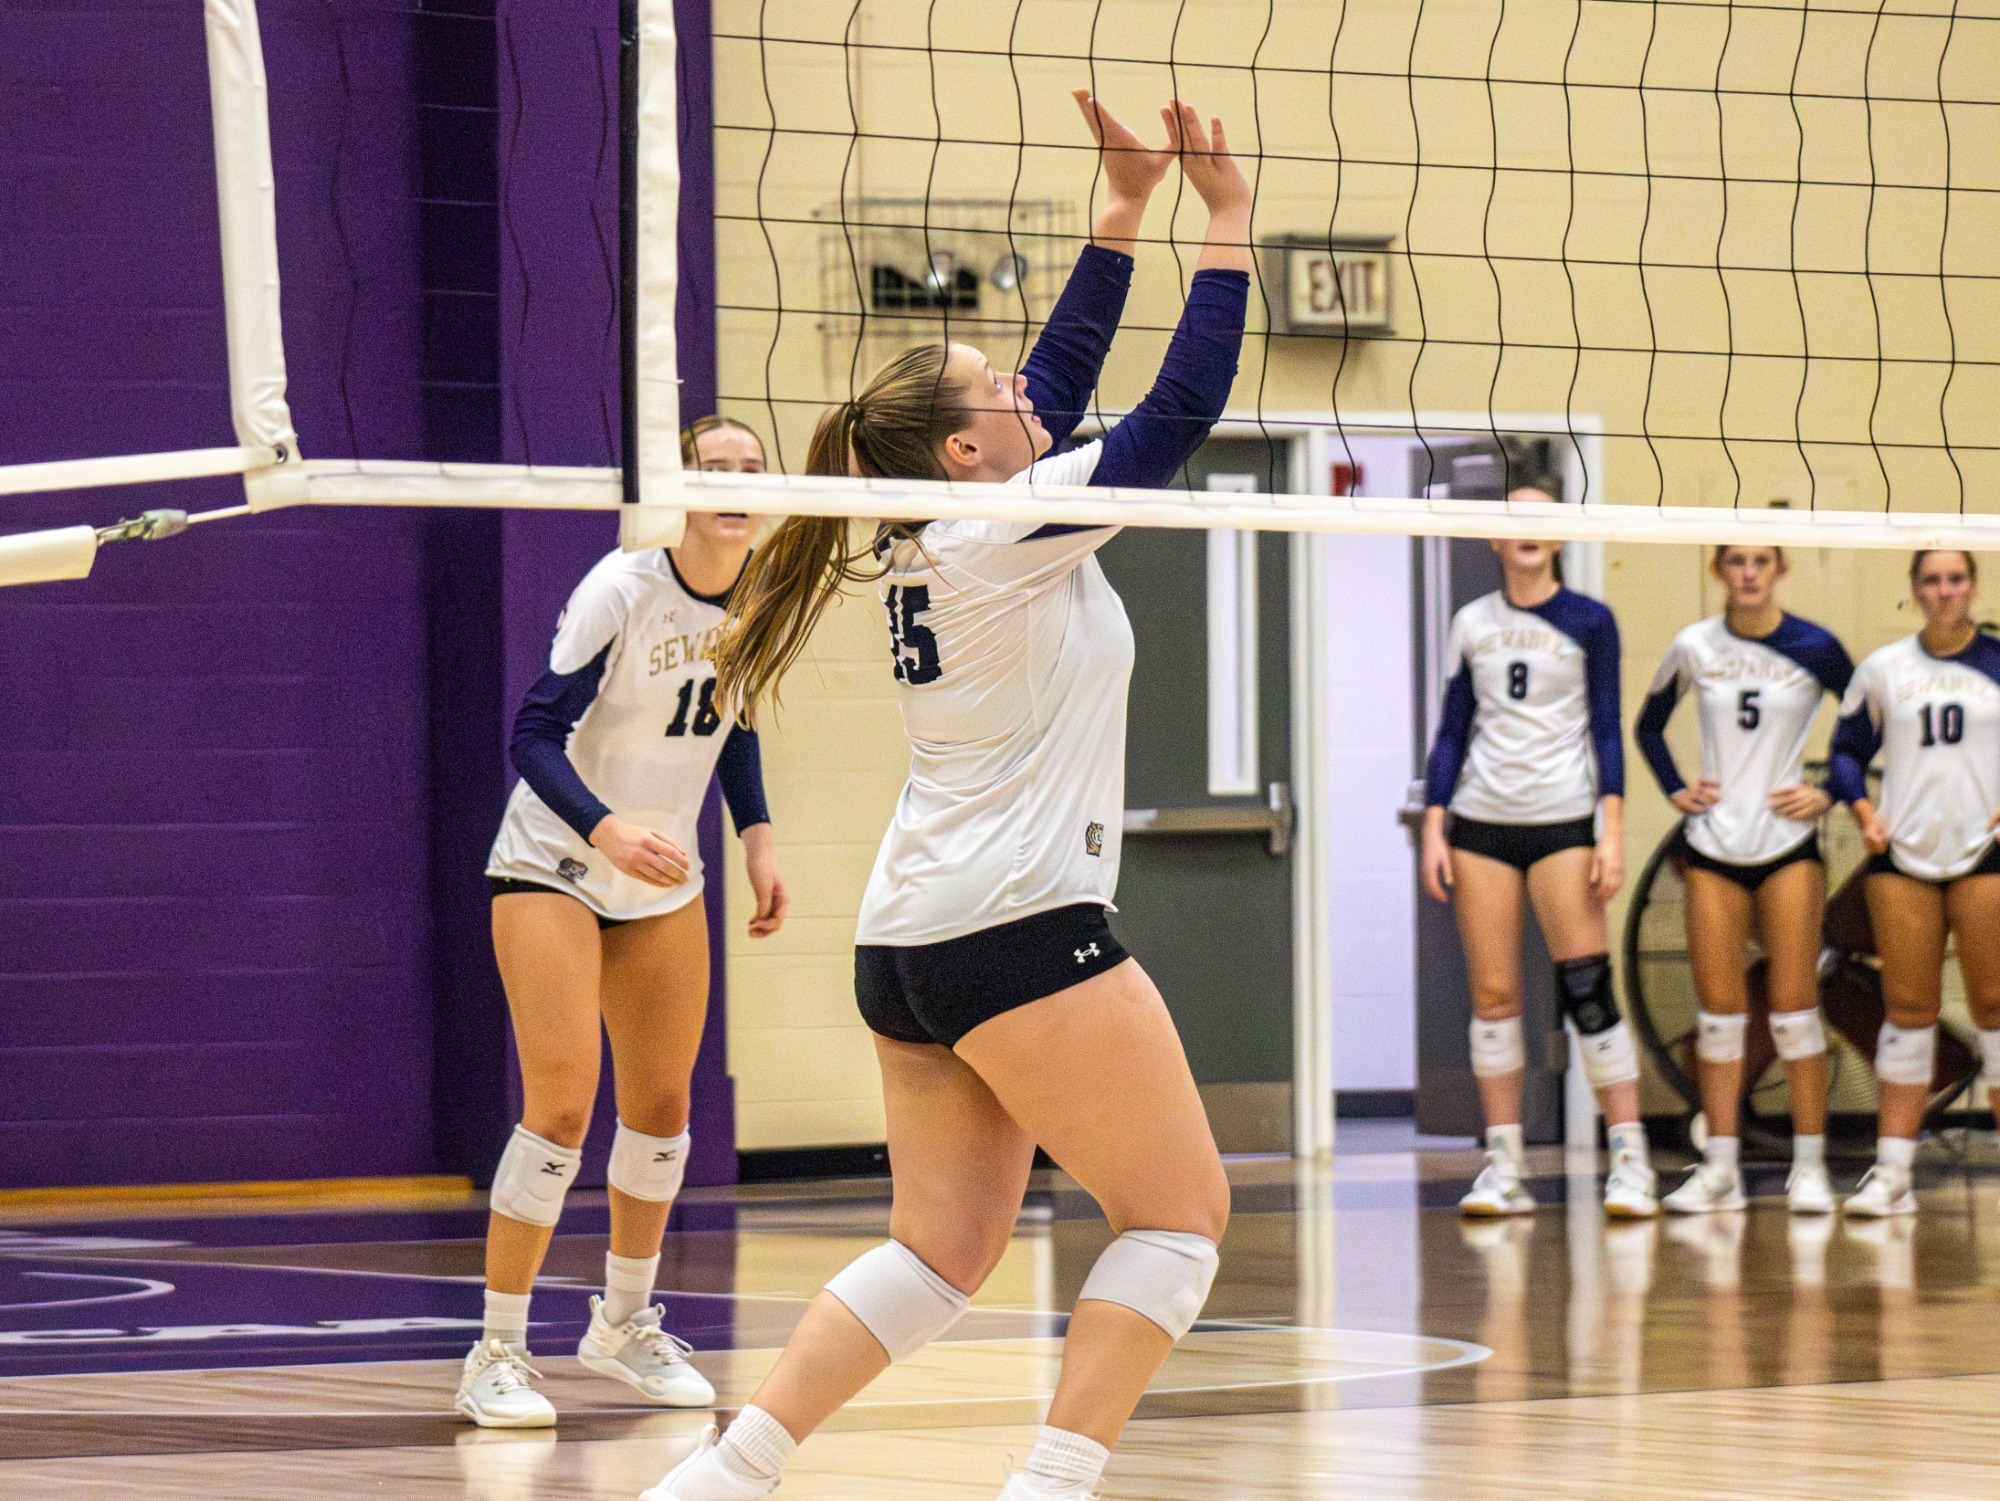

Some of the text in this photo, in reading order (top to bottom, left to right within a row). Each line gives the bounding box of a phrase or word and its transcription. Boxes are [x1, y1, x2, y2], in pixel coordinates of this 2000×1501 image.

[1307, 258, 1377, 313] EXIT
[885, 583, 943, 686] 15
[1507, 661, 1528, 701] 8
[1738, 689, 1761, 731] 5
[1918, 702, 1965, 747] 10
